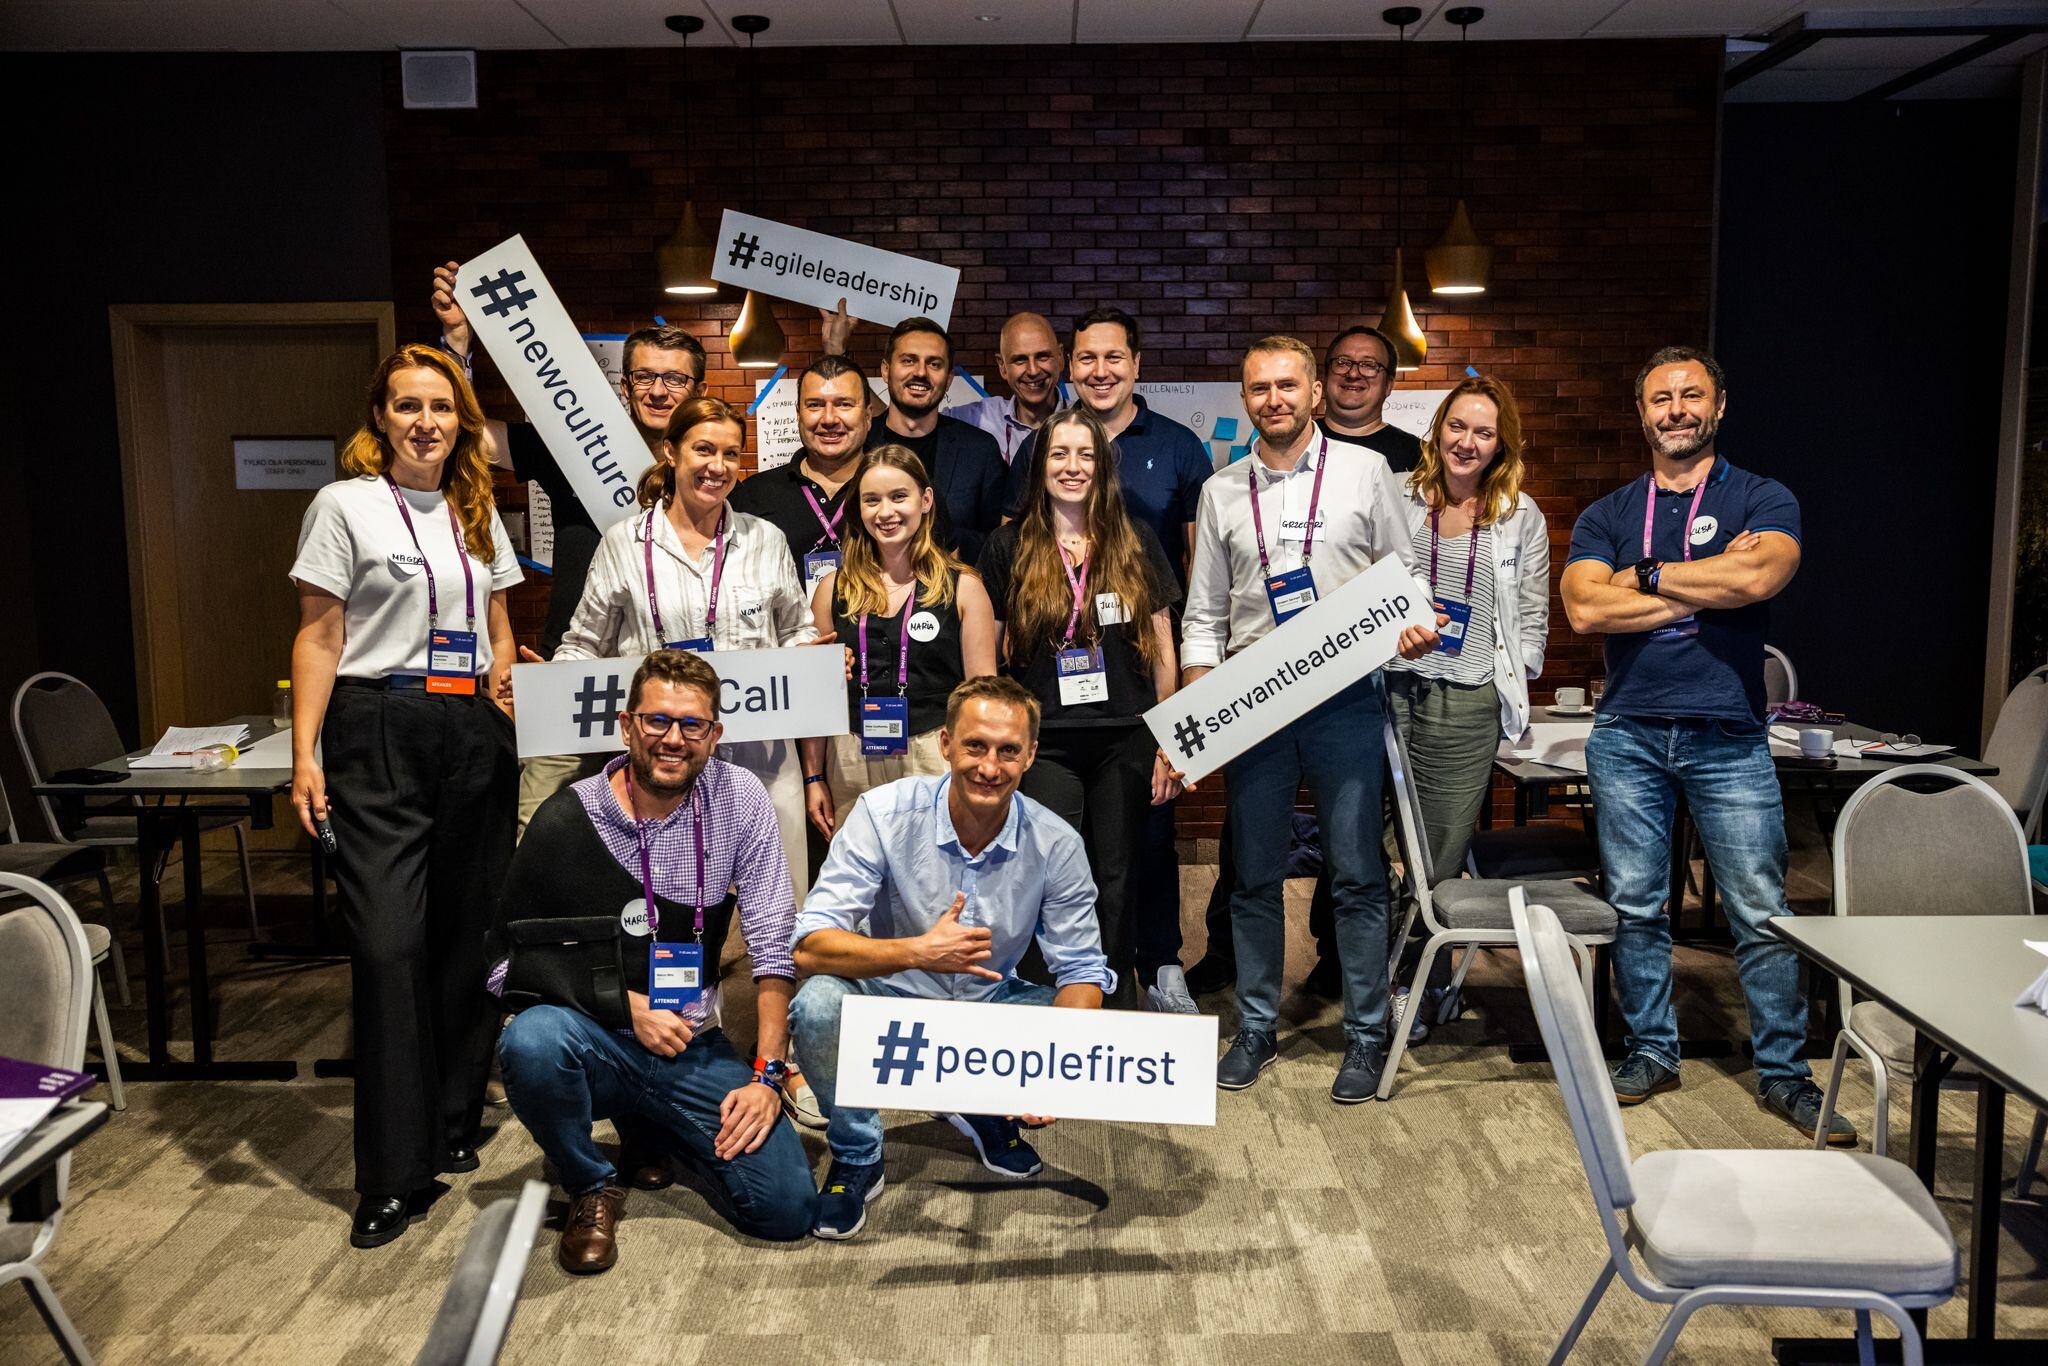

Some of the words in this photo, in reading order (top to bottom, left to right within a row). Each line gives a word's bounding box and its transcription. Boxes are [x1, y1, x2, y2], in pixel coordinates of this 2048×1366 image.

[728, 232, 938, 314] #agileleadership
[470, 268, 637, 508] #newculture
[1173, 595, 1410, 759] #servantleadership
[872, 1020, 1176, 1087] #peoplefirst
